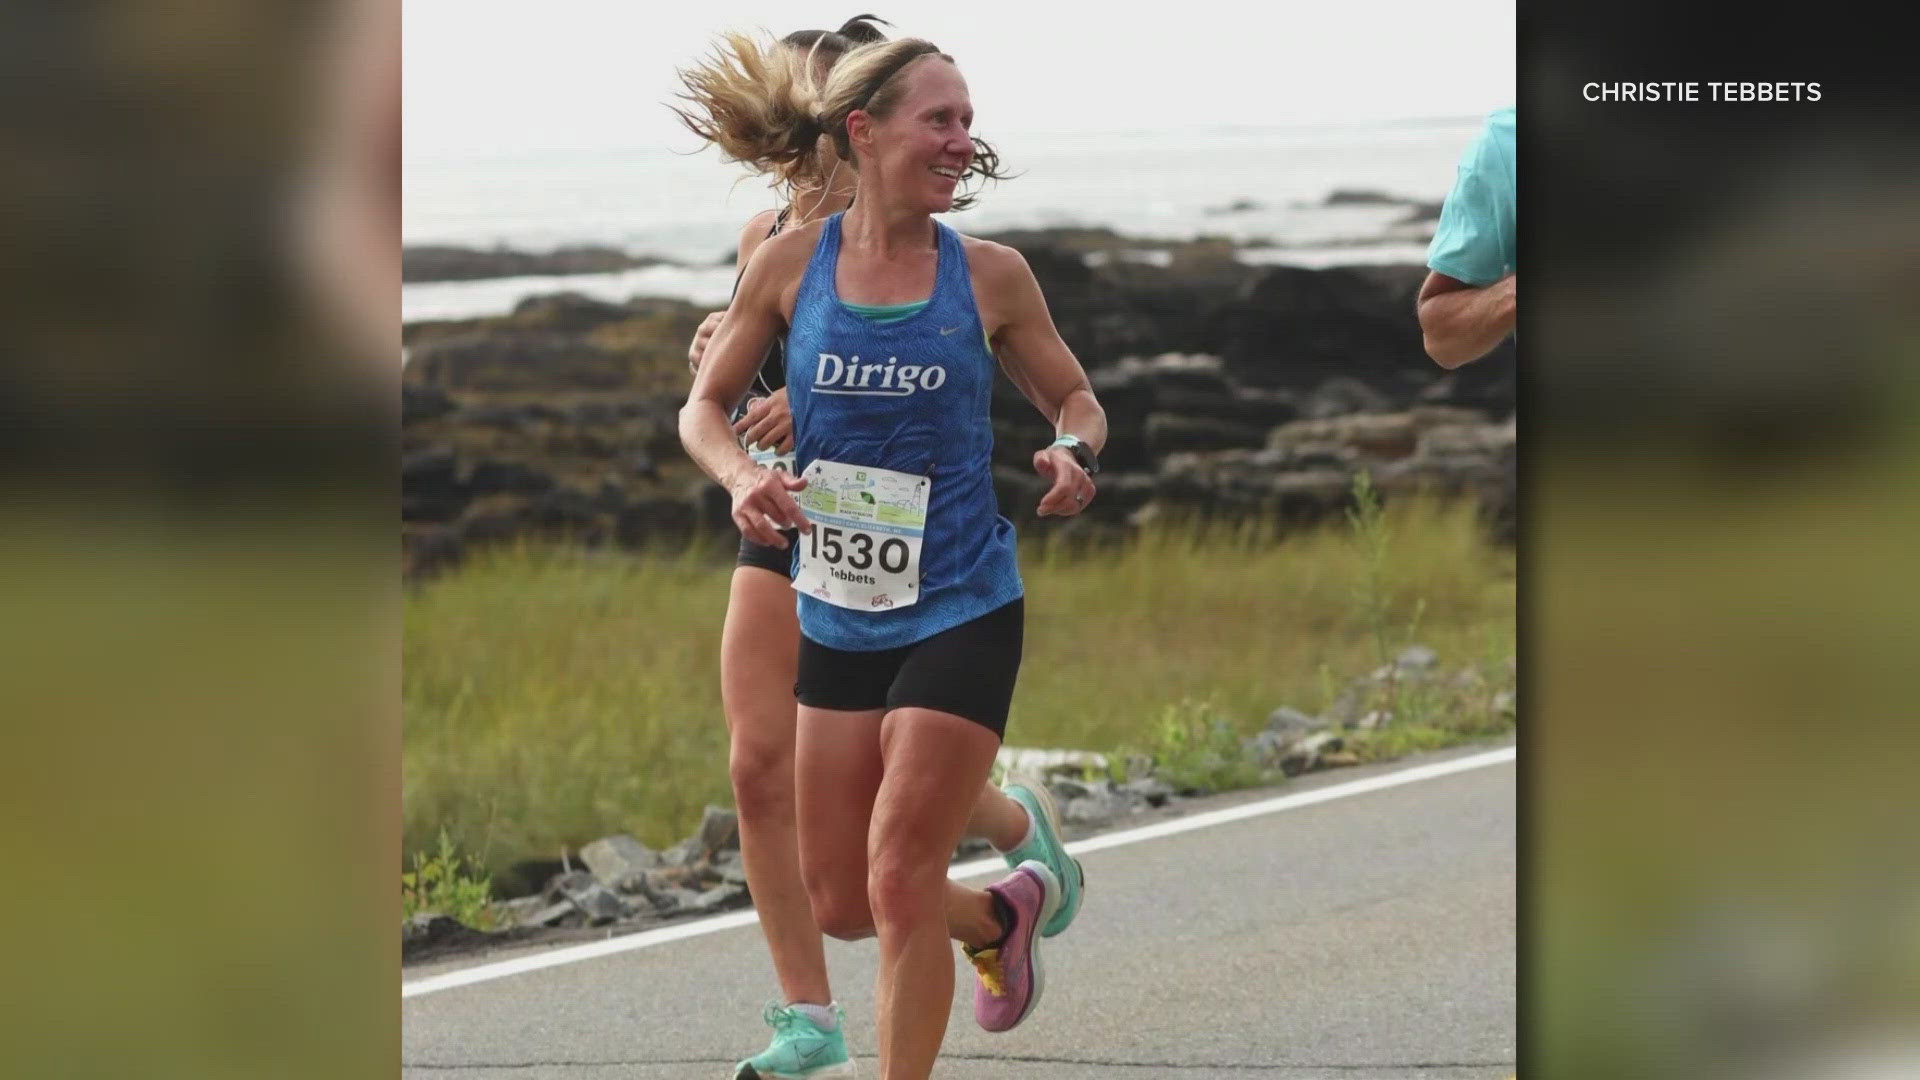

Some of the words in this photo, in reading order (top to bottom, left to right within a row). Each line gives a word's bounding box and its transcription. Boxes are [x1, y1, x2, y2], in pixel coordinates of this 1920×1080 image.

[811, 353, 946, 396] Dirigo
[810, 523, 910, 574] 1530
[829, 567, 876, 585] Tebbets
